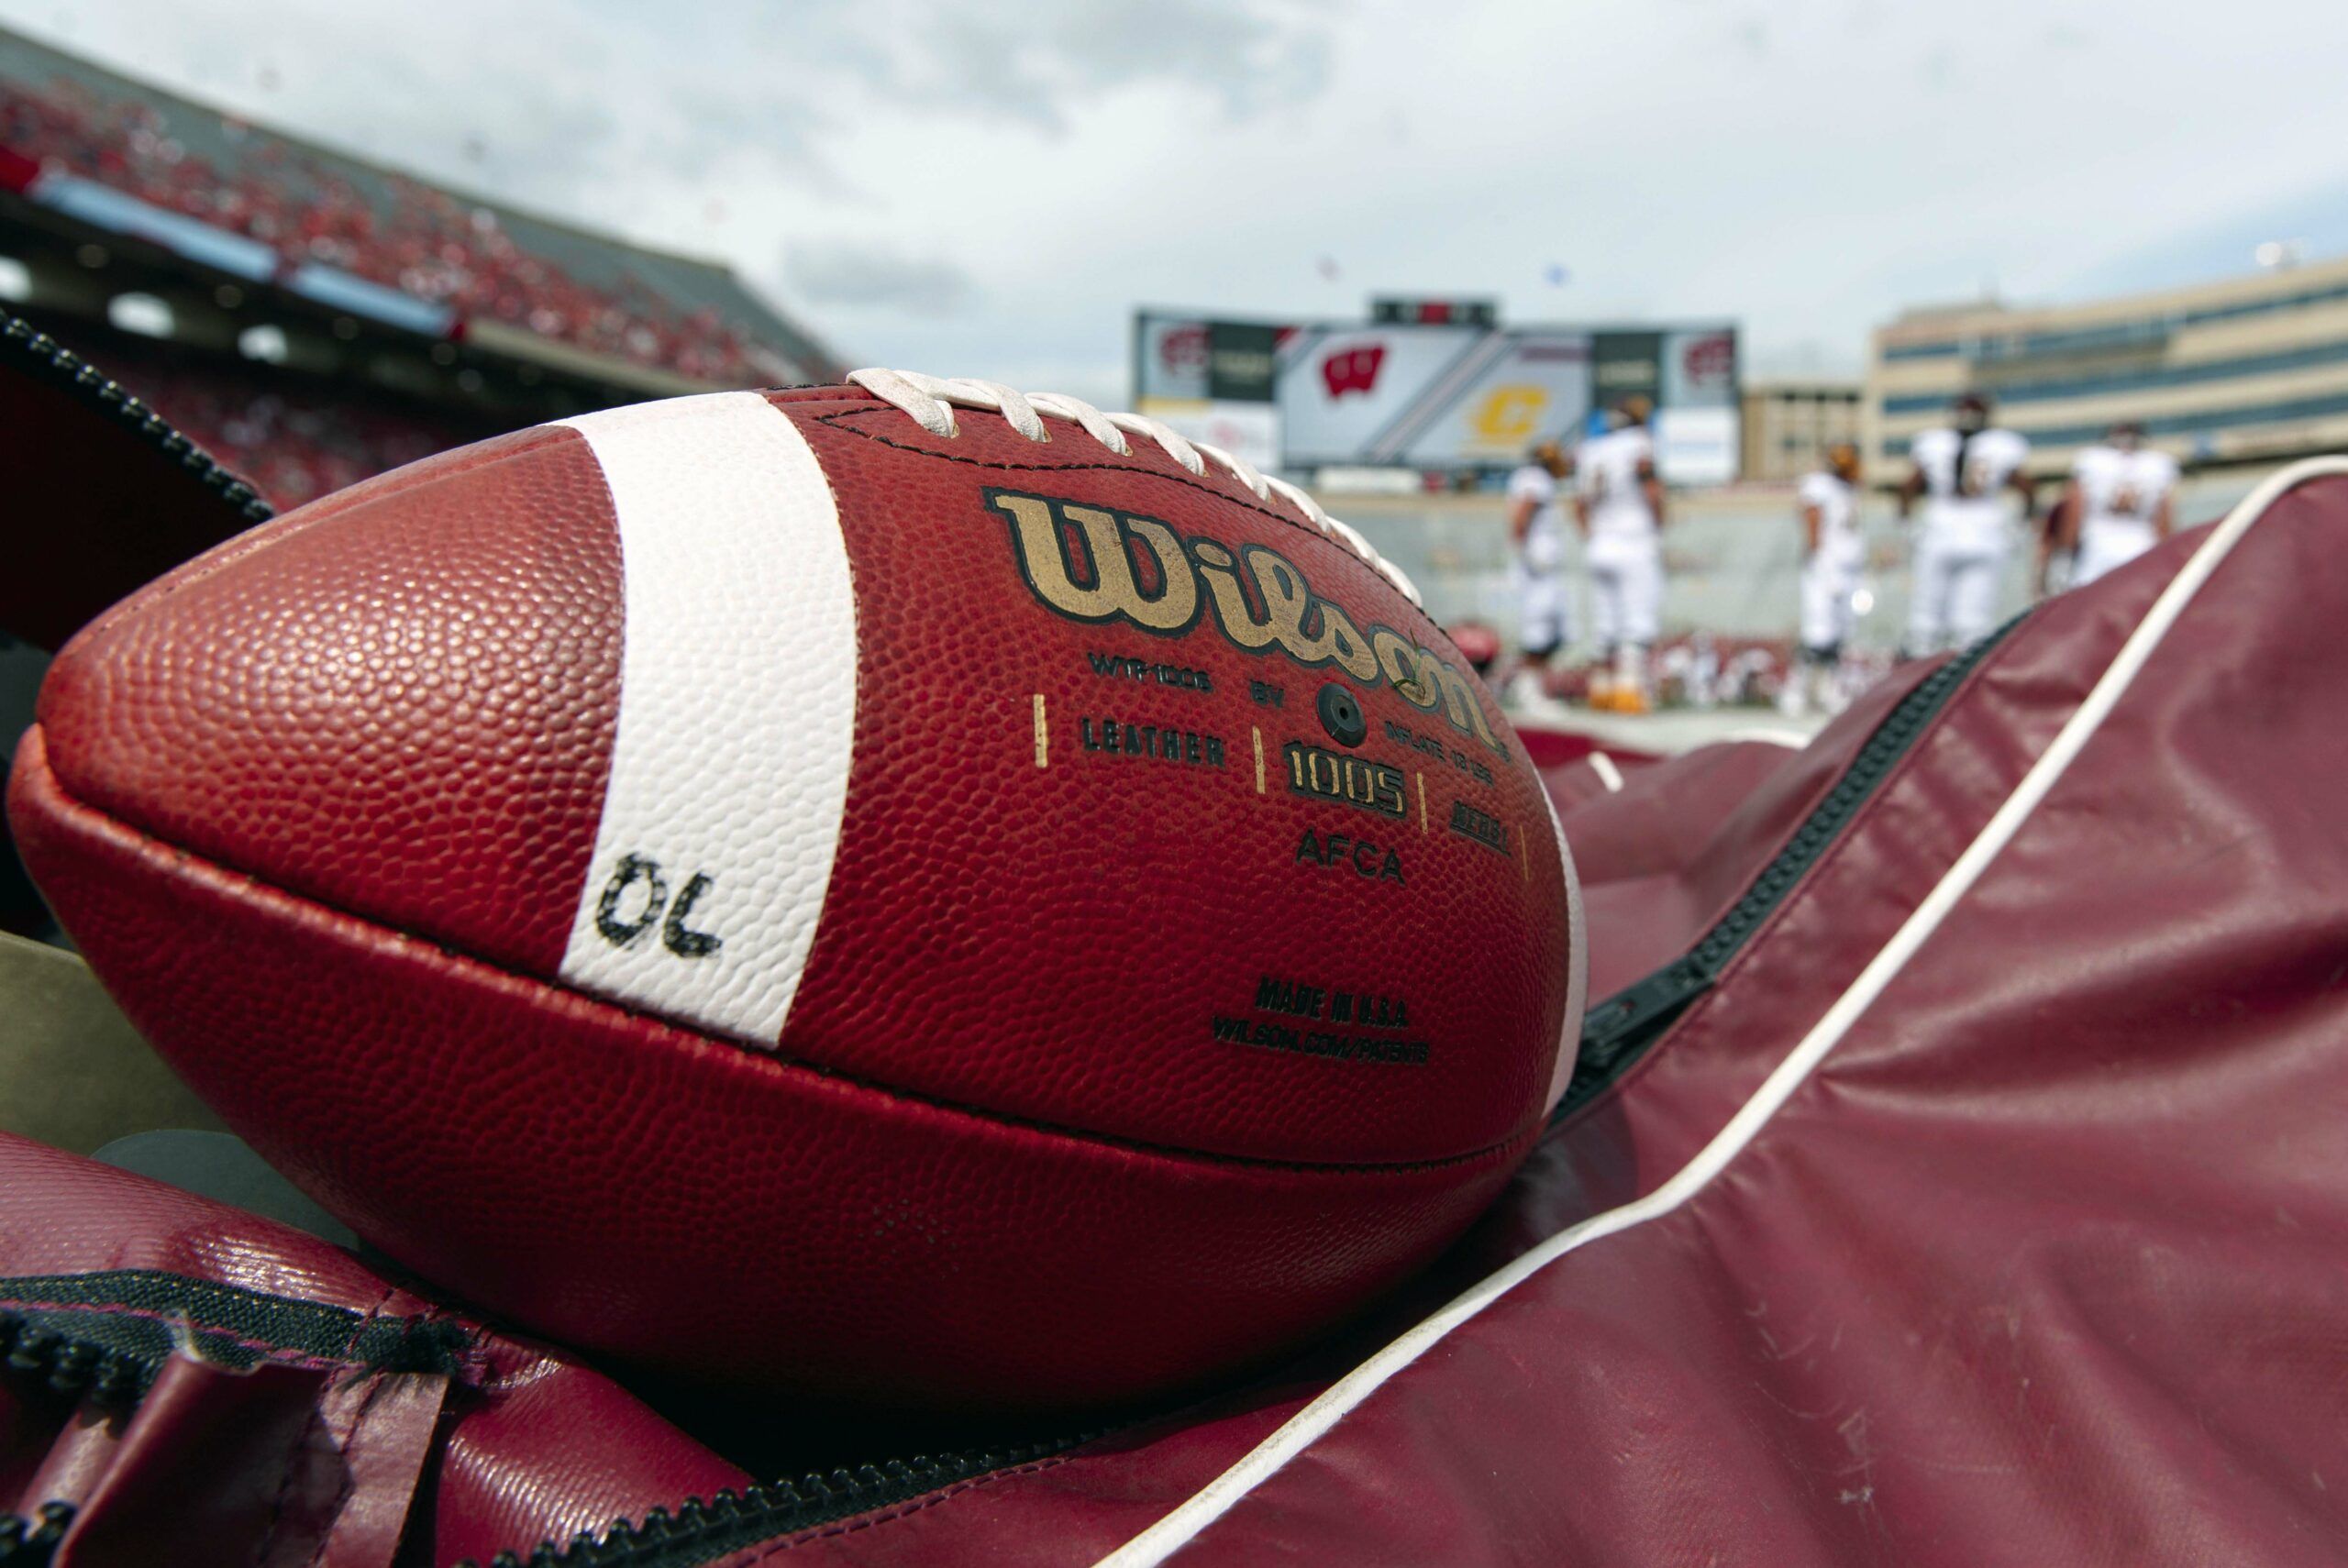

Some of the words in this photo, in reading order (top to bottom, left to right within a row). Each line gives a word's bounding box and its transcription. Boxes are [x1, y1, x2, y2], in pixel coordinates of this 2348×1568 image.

[982, 487, 1502, 763] Wilson
[1082, 717, 1225, 770] LEATHER
[1284, 741, 1408, 820] 1005
[1294, 827, 1406, 887] AFCA
[596, 852, 723, 957] OL
[1255, 976, 1326, 1018] MADE
[1330, 990, 1355, 1023] IN
[1213, 1016, 1430, 1064] WILSON.COM/PATENTS
